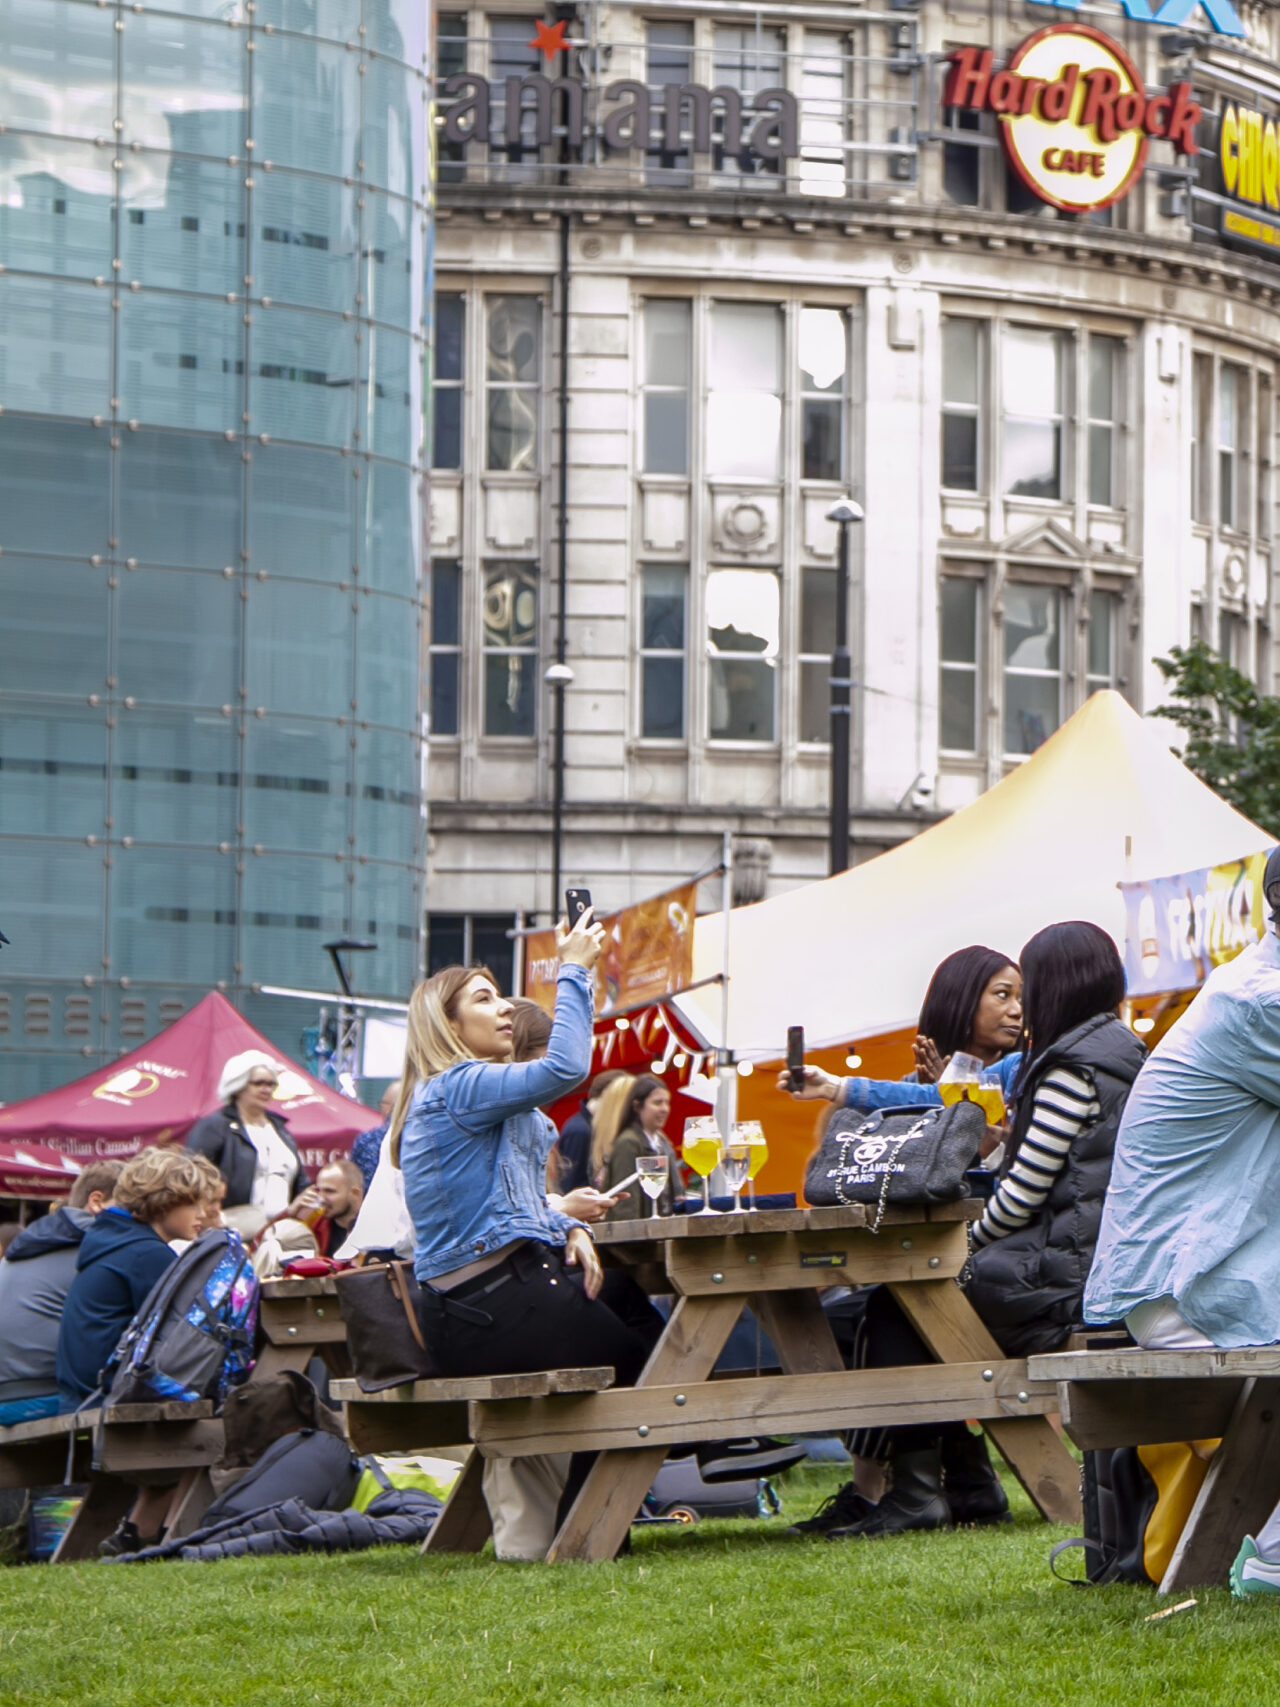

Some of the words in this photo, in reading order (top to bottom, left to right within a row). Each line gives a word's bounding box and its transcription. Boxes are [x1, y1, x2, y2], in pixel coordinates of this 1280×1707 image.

[944, 47, 1080, 120] Hard
[1077, 68, 1203, 154] Rock
[1042, 147, 1106, 178] CAFE
[846, 1174, 876, 1184] PARIS
